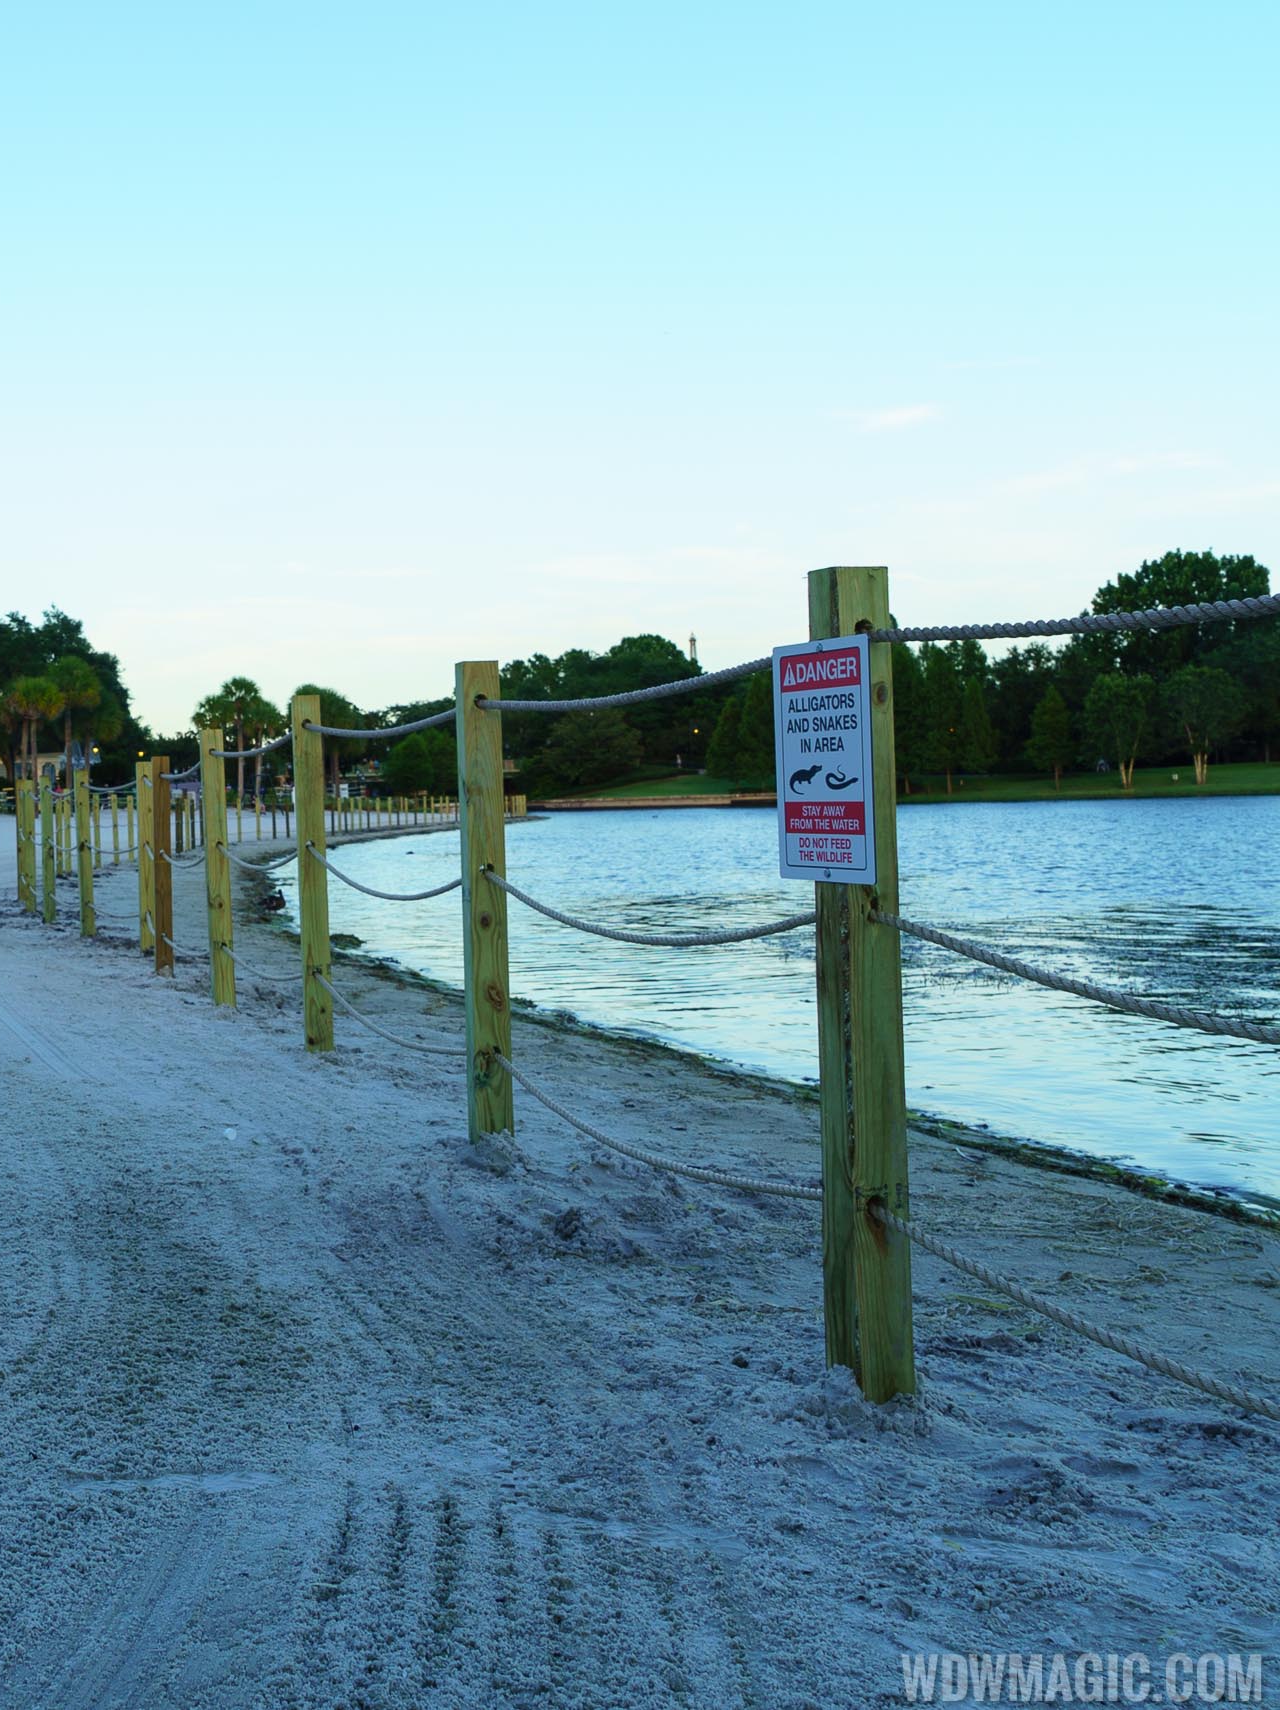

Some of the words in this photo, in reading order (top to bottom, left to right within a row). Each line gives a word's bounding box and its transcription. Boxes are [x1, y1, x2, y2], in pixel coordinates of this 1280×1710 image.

[796, 656, 857, 683] DANGER
[788, 693, 855, 713] ALLIGATORS
[787, 717, 810, 734] AND
[812, 714, 858, 732] SNAKES
[800, 738, 812, 753] IN
[814, 736, 845, 752] AREA
[802, 805, 822, 817] STAY
[822, 805, 845, 817] AWAY
[790, 819, 813, 830] FROM
[814, 819, 831, 830] THE
[831, 819, 860, 831] WATER
[799, 837, 811, 849] DO
[812, 837, 830, 850] NOT
[831, 838, 851, 850] FEED
[799, 850, 814, 862] THE
[816, 851, 852, 864] WILDLIFE
